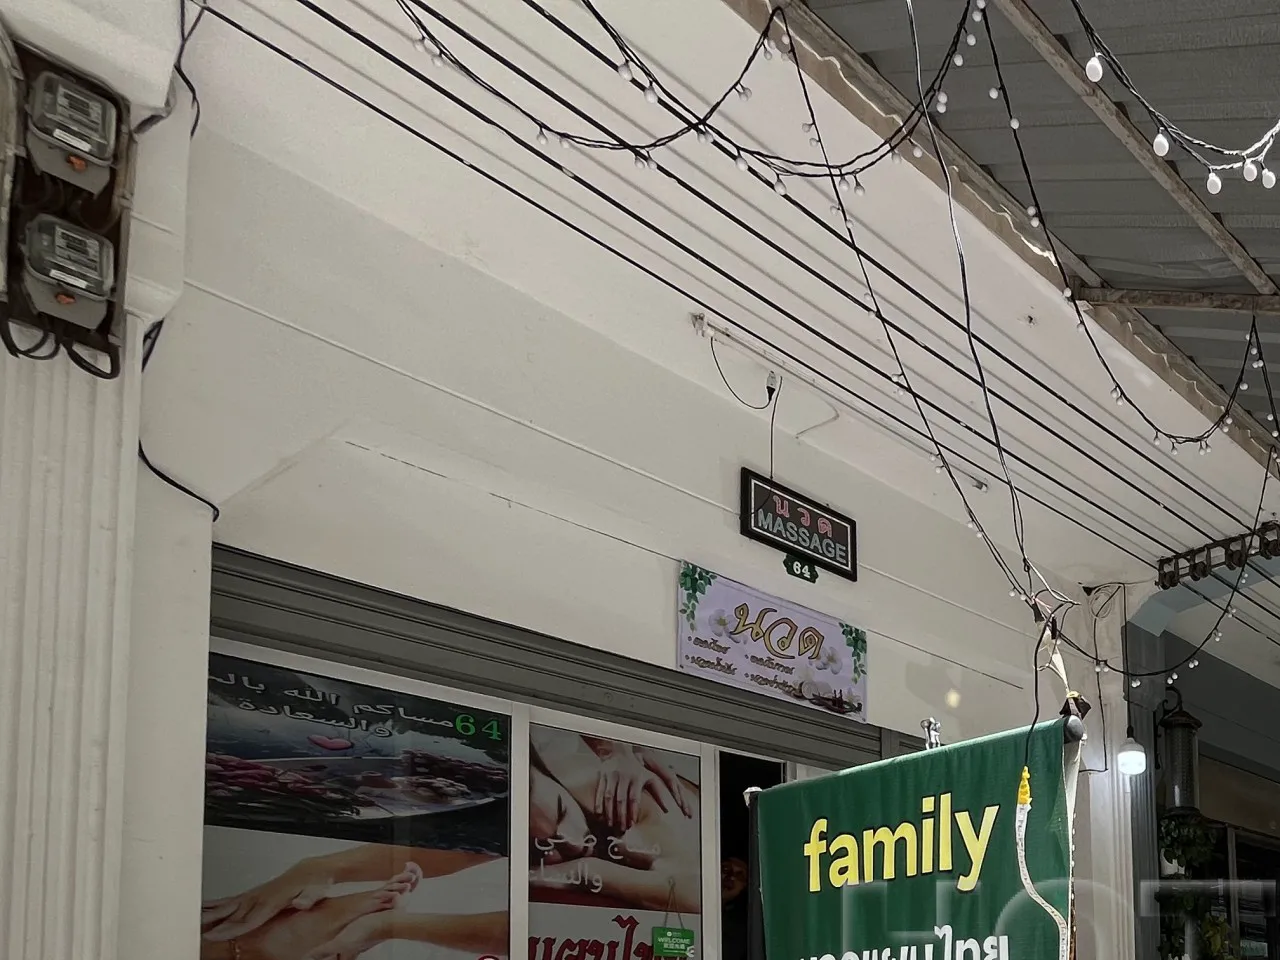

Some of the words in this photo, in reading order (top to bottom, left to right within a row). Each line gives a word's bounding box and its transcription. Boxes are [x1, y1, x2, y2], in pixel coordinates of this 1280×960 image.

[773, 495, 833, 538] นวด
[757, 508, 847, 564] MASSAGE
[792, 561, 812, 579] 64
[730, 603, 824, 660] นวด
[283, 684, 341, 706] الله
[238, 697, 394, 738] والسعادة
[351, 702, 454, 729] مساكم
[454, 714, 503, 741] 64
[804, 792, 999, 893] family
[657, 937, 691, 945] WELCOME
